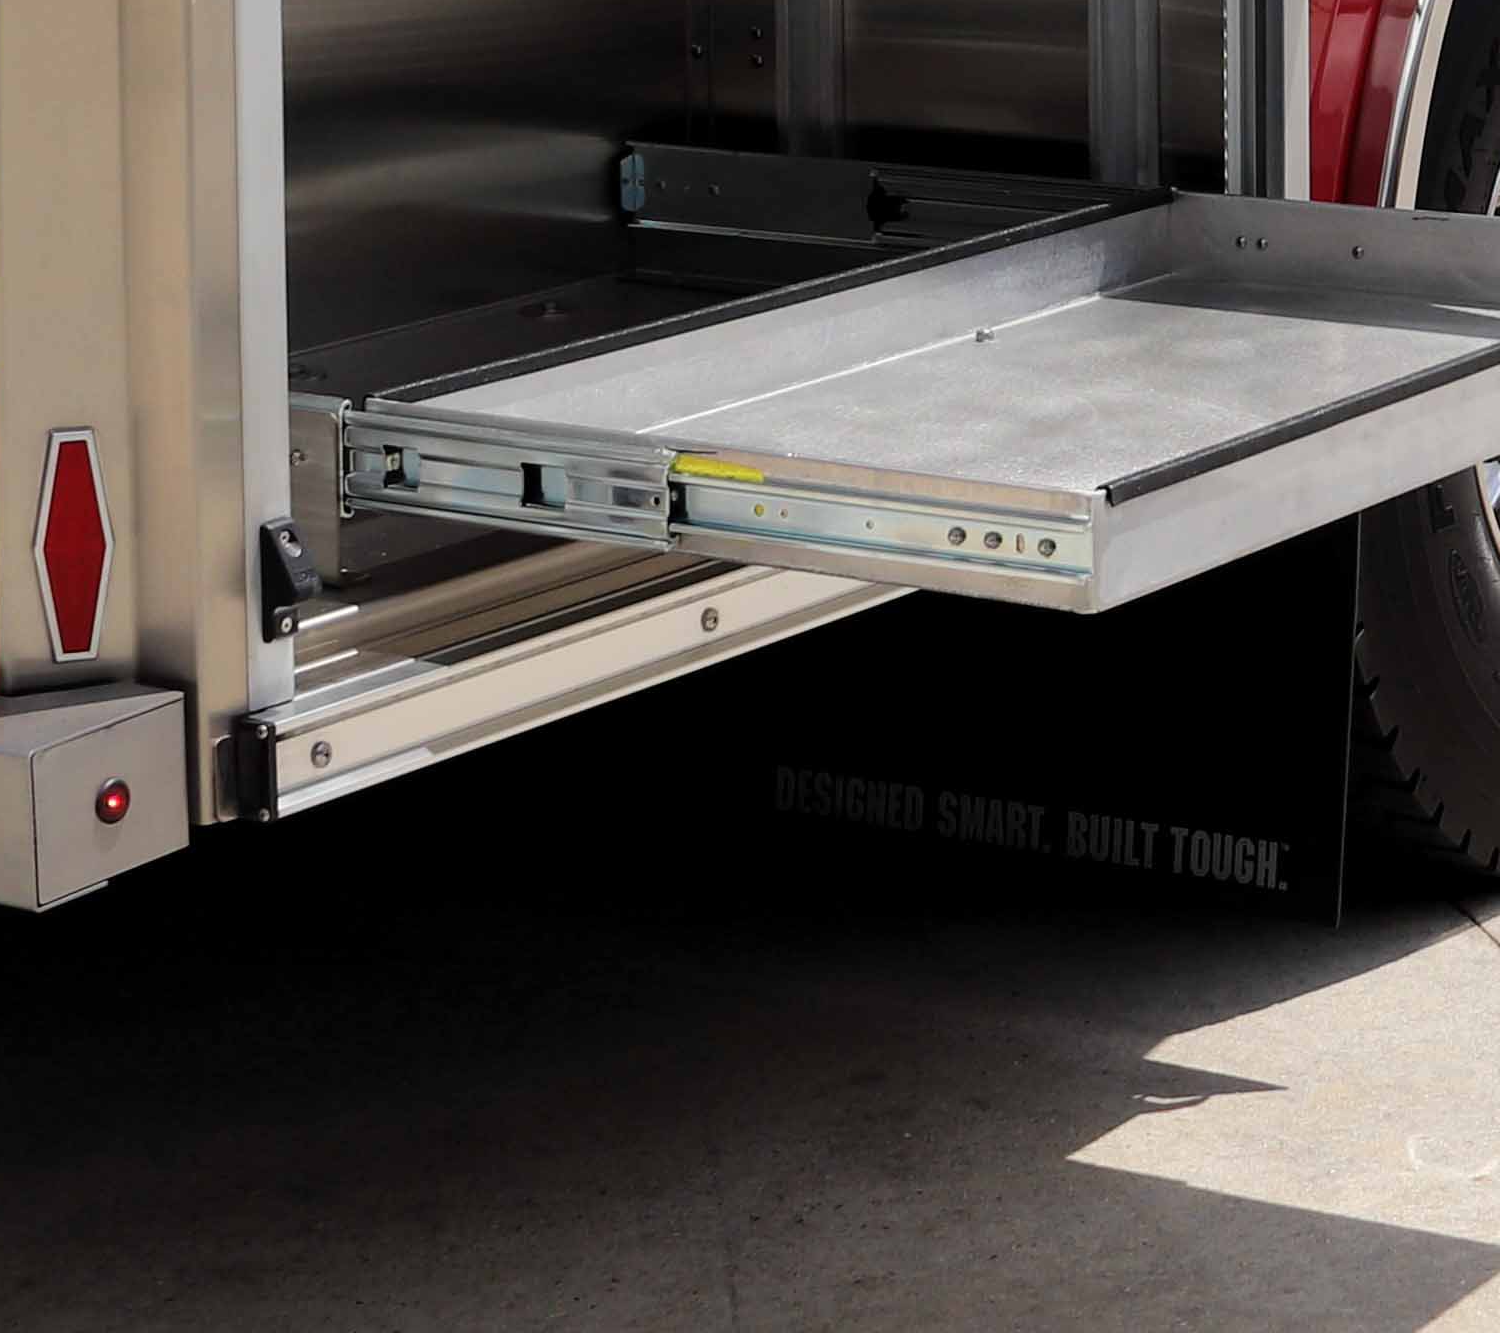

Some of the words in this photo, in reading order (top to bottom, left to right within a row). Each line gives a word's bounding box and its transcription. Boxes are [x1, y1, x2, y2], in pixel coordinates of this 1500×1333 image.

[774, 764, 924, 831] DESIGNED
[937, 789, 1052, 854] SMART.
[1067, 810, 1161, 869] BUILT
